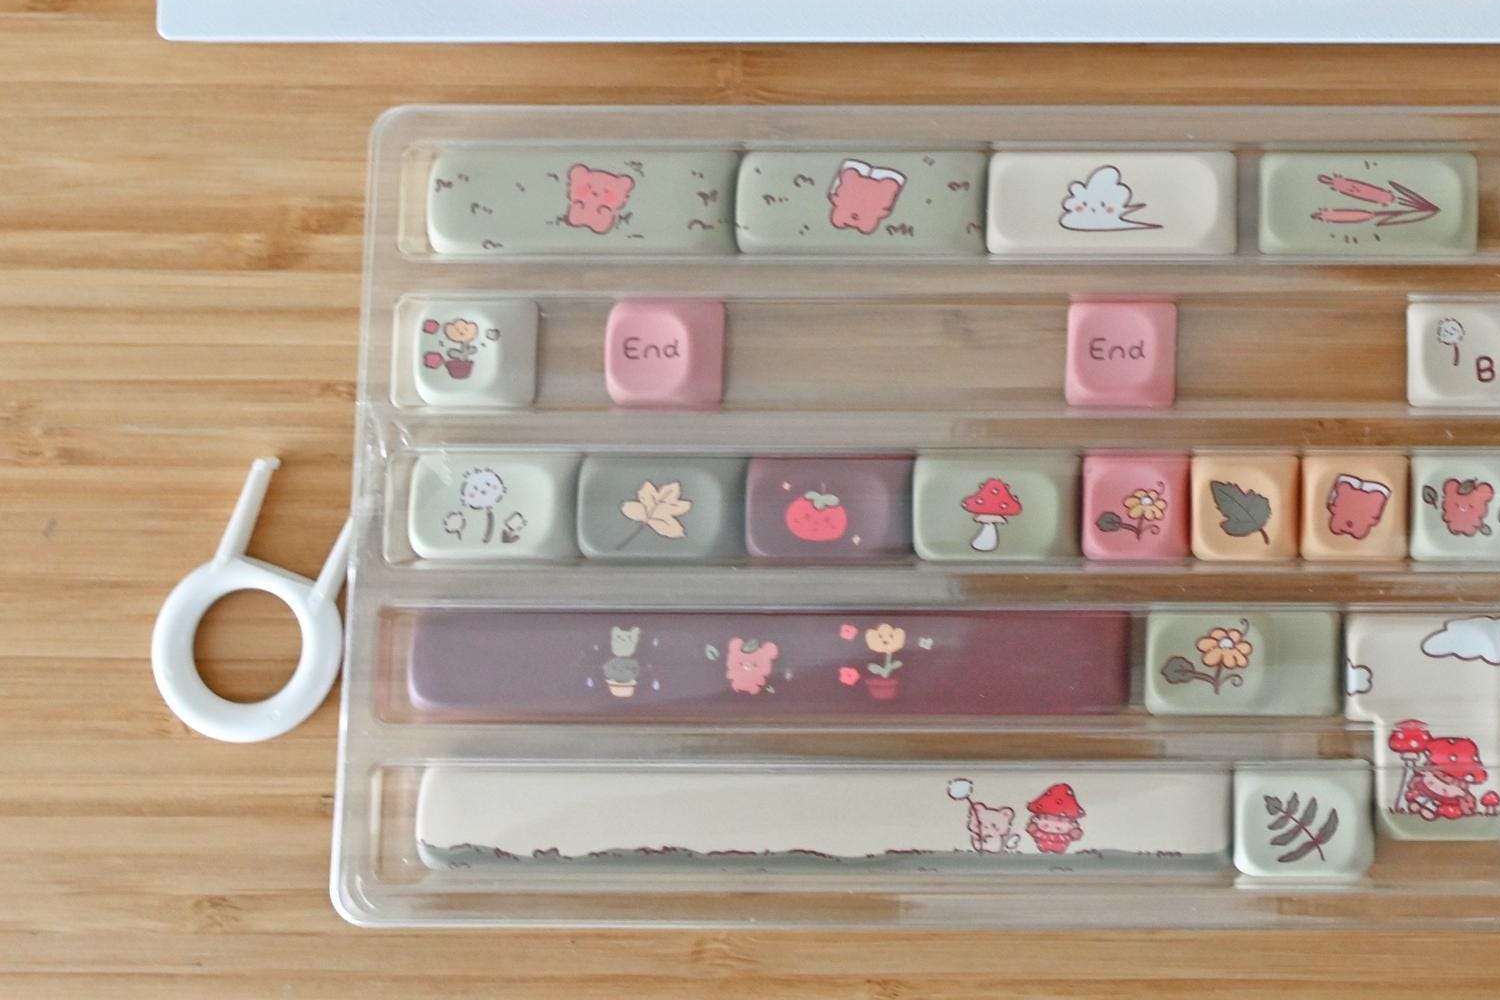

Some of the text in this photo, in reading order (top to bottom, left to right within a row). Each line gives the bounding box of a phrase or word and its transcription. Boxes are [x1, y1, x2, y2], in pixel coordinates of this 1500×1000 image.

[623, 337, 681, 361] End
[1089, 337, 1147, 361] End
[1475, 356, 1495, 383] B
